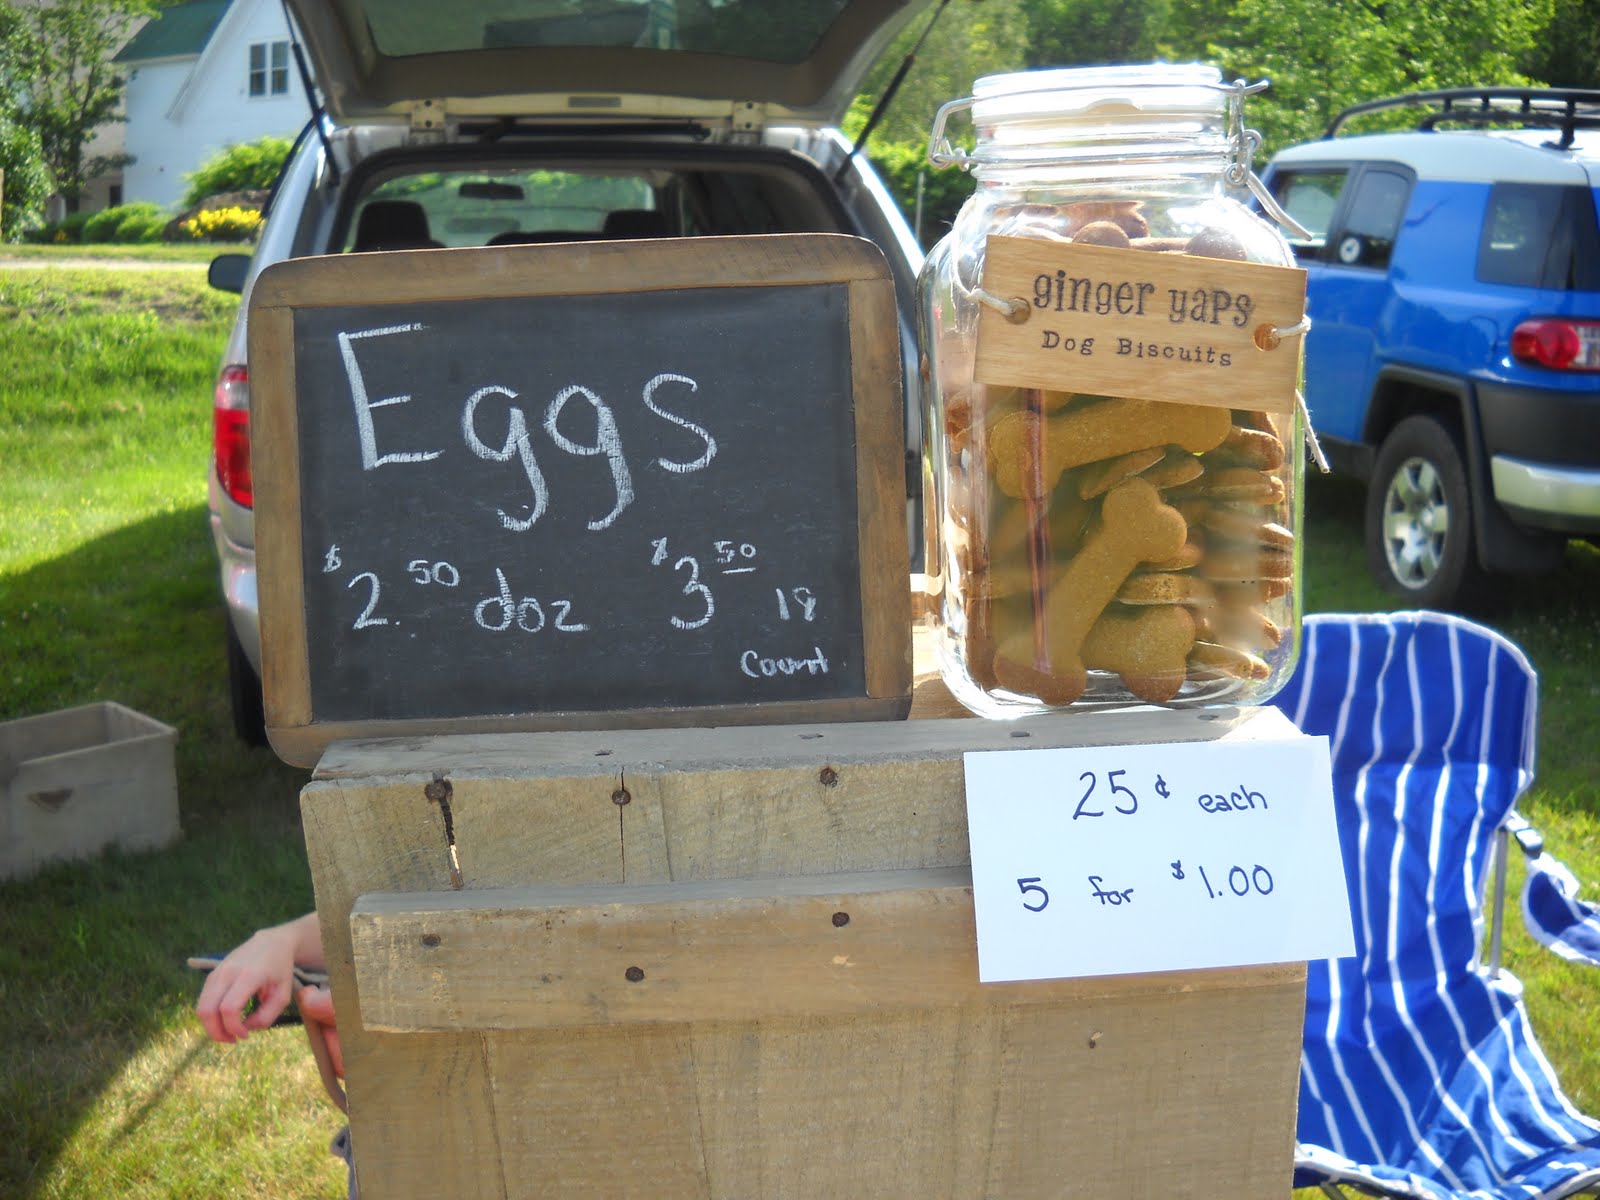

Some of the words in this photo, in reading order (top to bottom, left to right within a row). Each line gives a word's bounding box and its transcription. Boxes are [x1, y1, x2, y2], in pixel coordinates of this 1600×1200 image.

[1033, 270, 1155, 316] ginger
[1042, 330, 1095, 355] Dog
[1117, 337, 1233, 366] Biscuits
[337, 322, 718, 532] Eggs
[474, 568, 590, 633] doz
[775, 586, 817, 622] 18
[1198, 784, 1268, 813] each
[1017, 876, 1050, 912] 5
[1088, 875, 1134, 905] for
